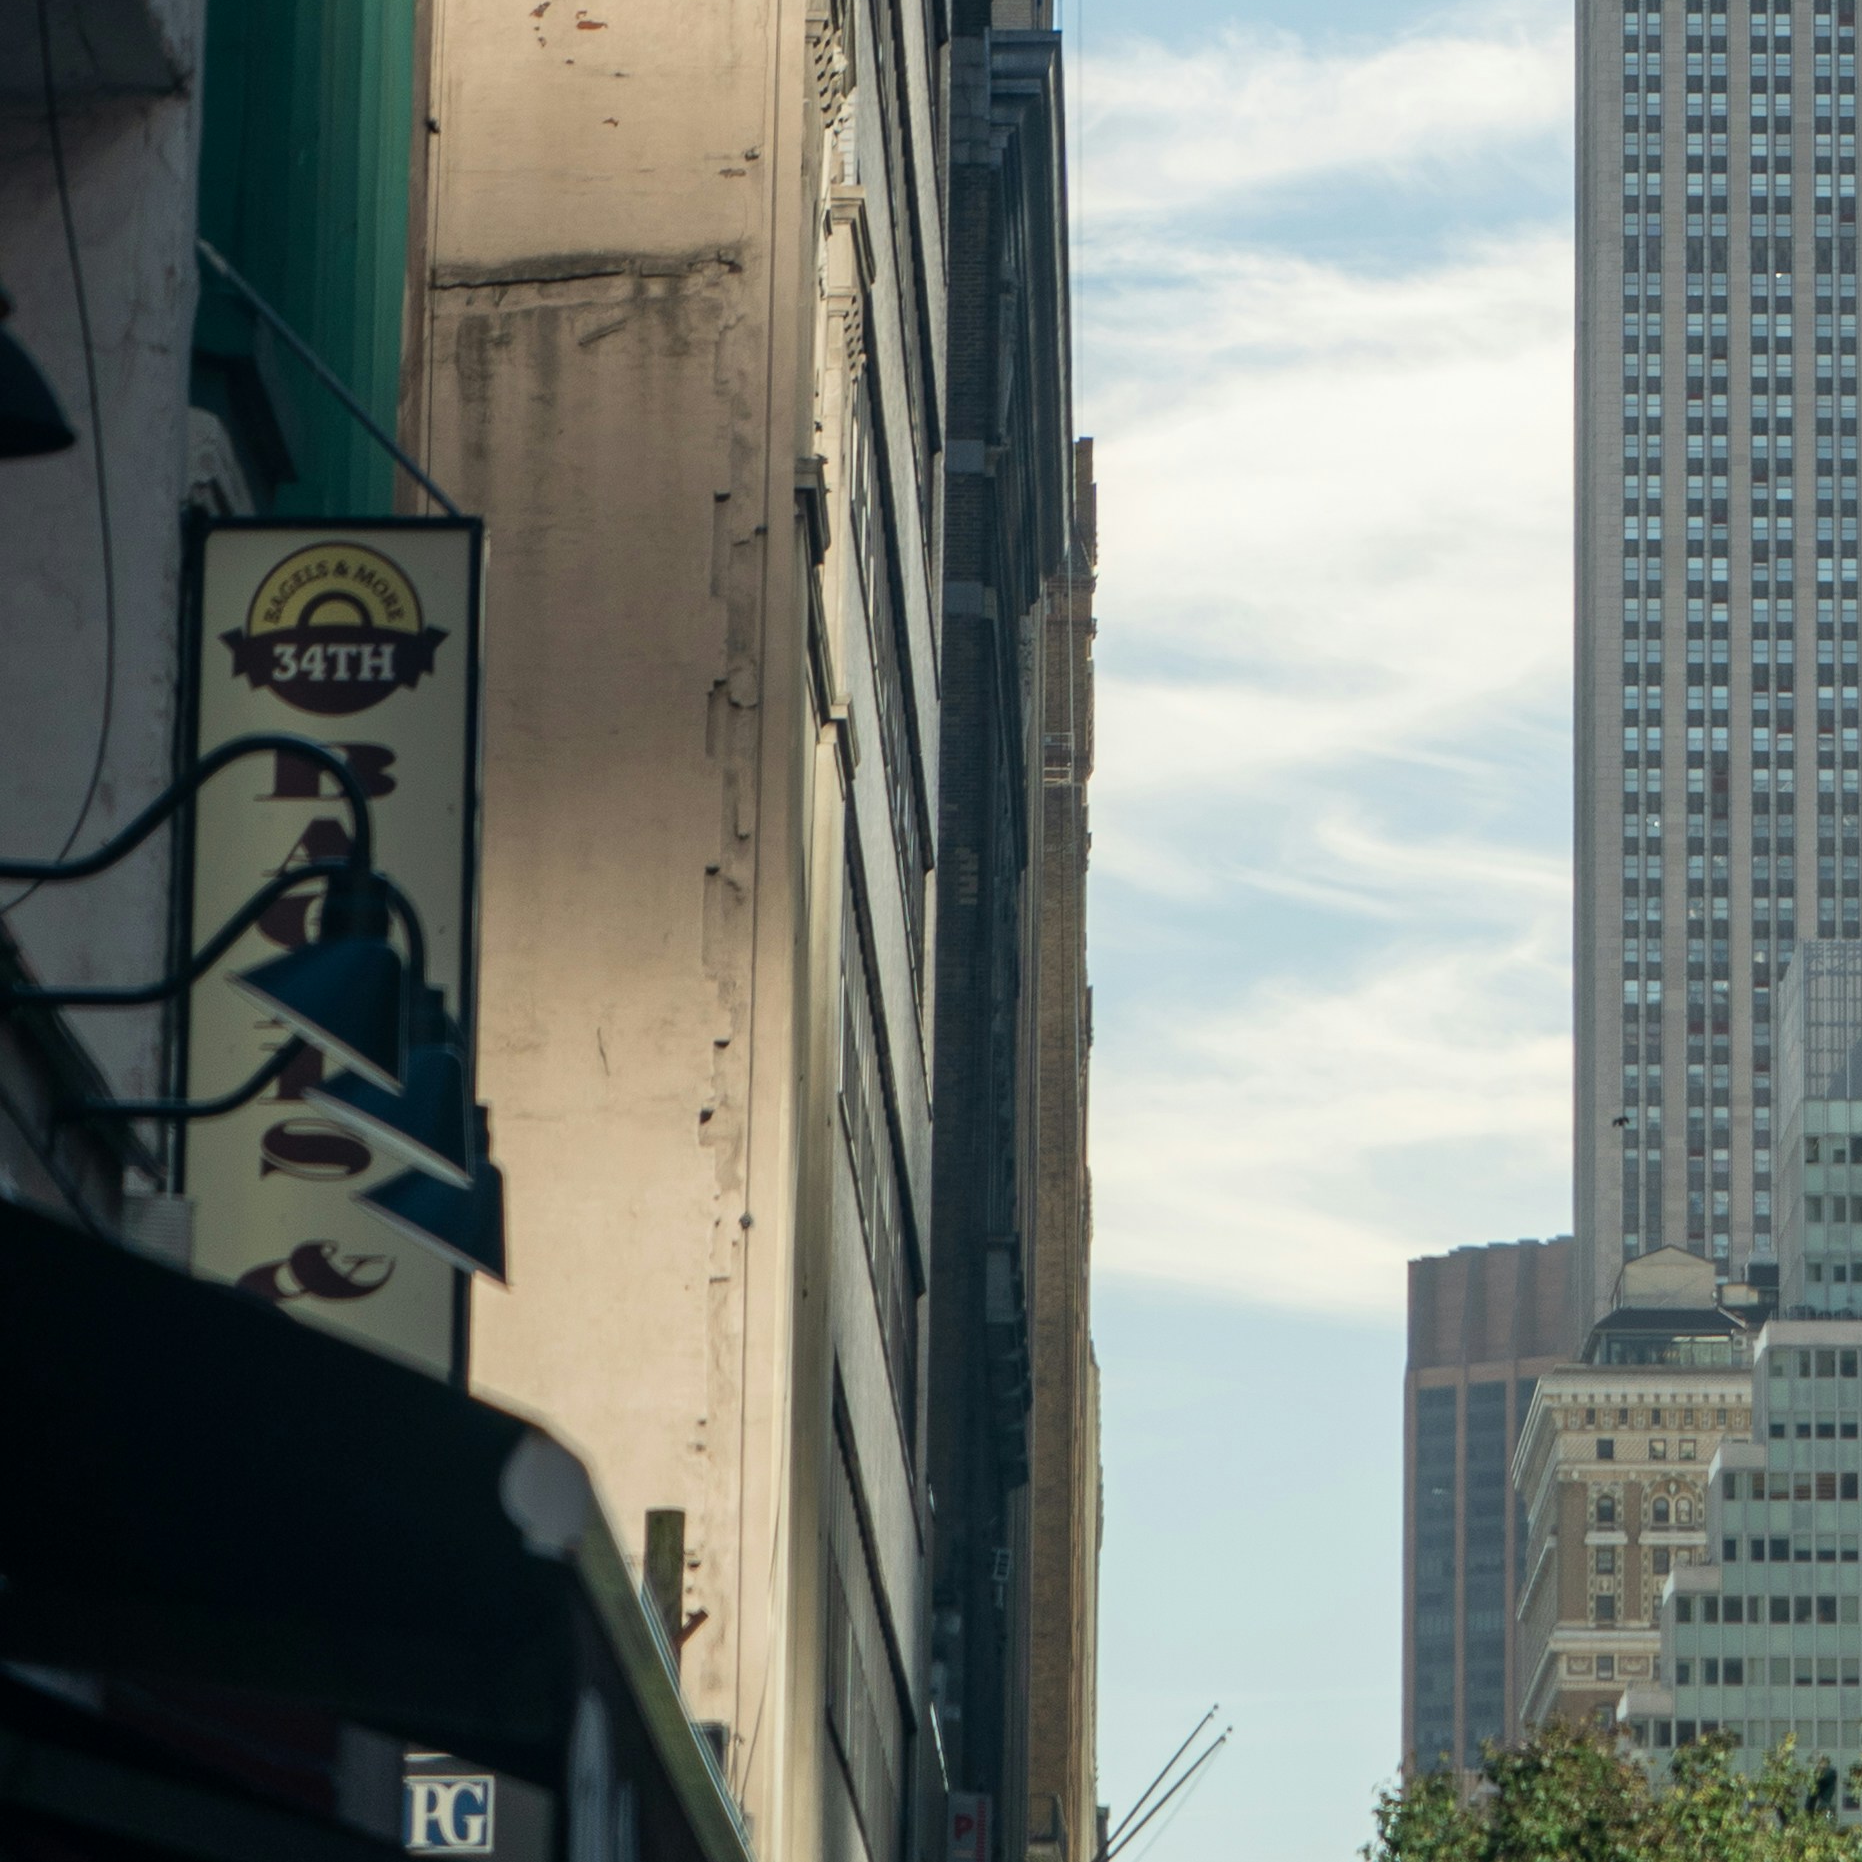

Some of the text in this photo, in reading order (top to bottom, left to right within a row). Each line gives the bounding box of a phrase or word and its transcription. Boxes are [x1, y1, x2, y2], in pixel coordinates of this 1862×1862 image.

[264, 558, 404, 623] BAGELS & MORE
[271, 642, 396, 682] 34TH
